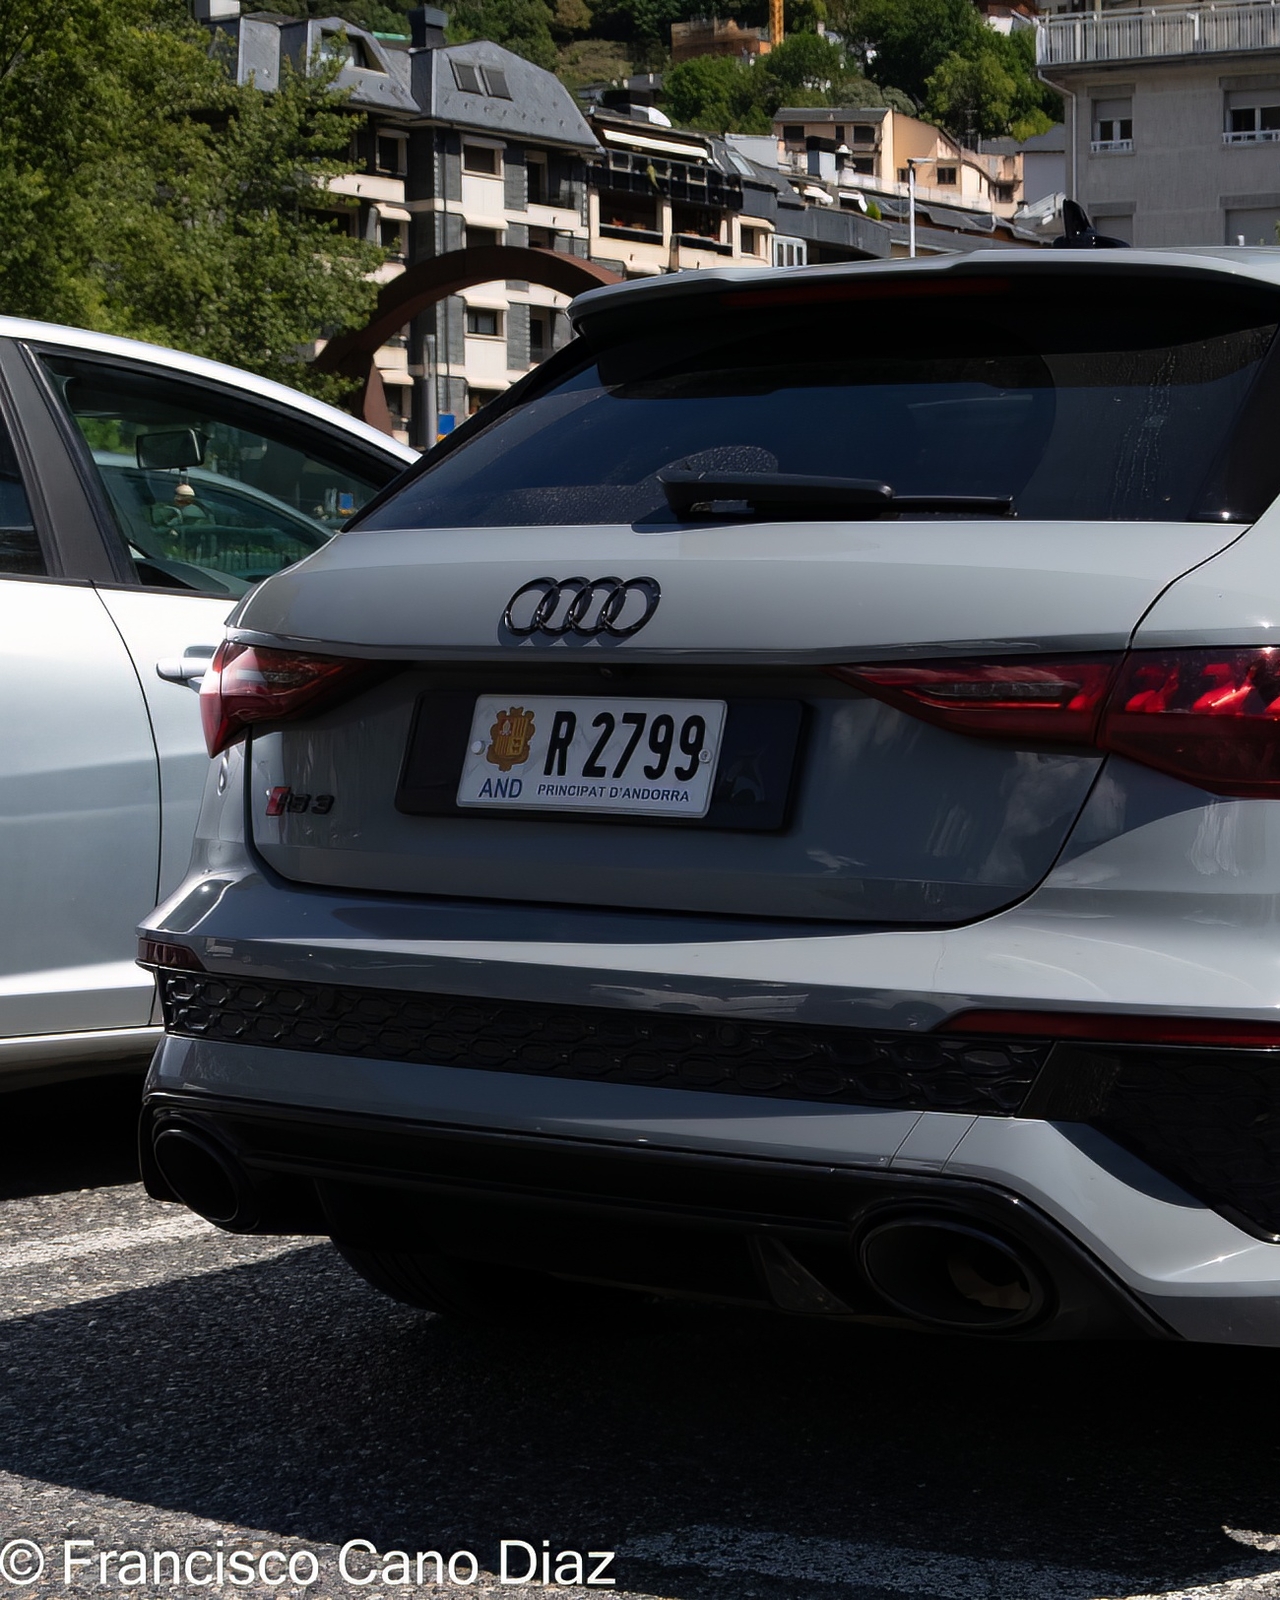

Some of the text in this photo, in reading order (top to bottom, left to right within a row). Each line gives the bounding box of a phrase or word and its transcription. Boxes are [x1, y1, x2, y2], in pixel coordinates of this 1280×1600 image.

[543, 711, 706, 781] R 2799
[478, 777, 523, 799] AND
[537, 784, 690, 802] PRINCIPAT D'ANDORRA
